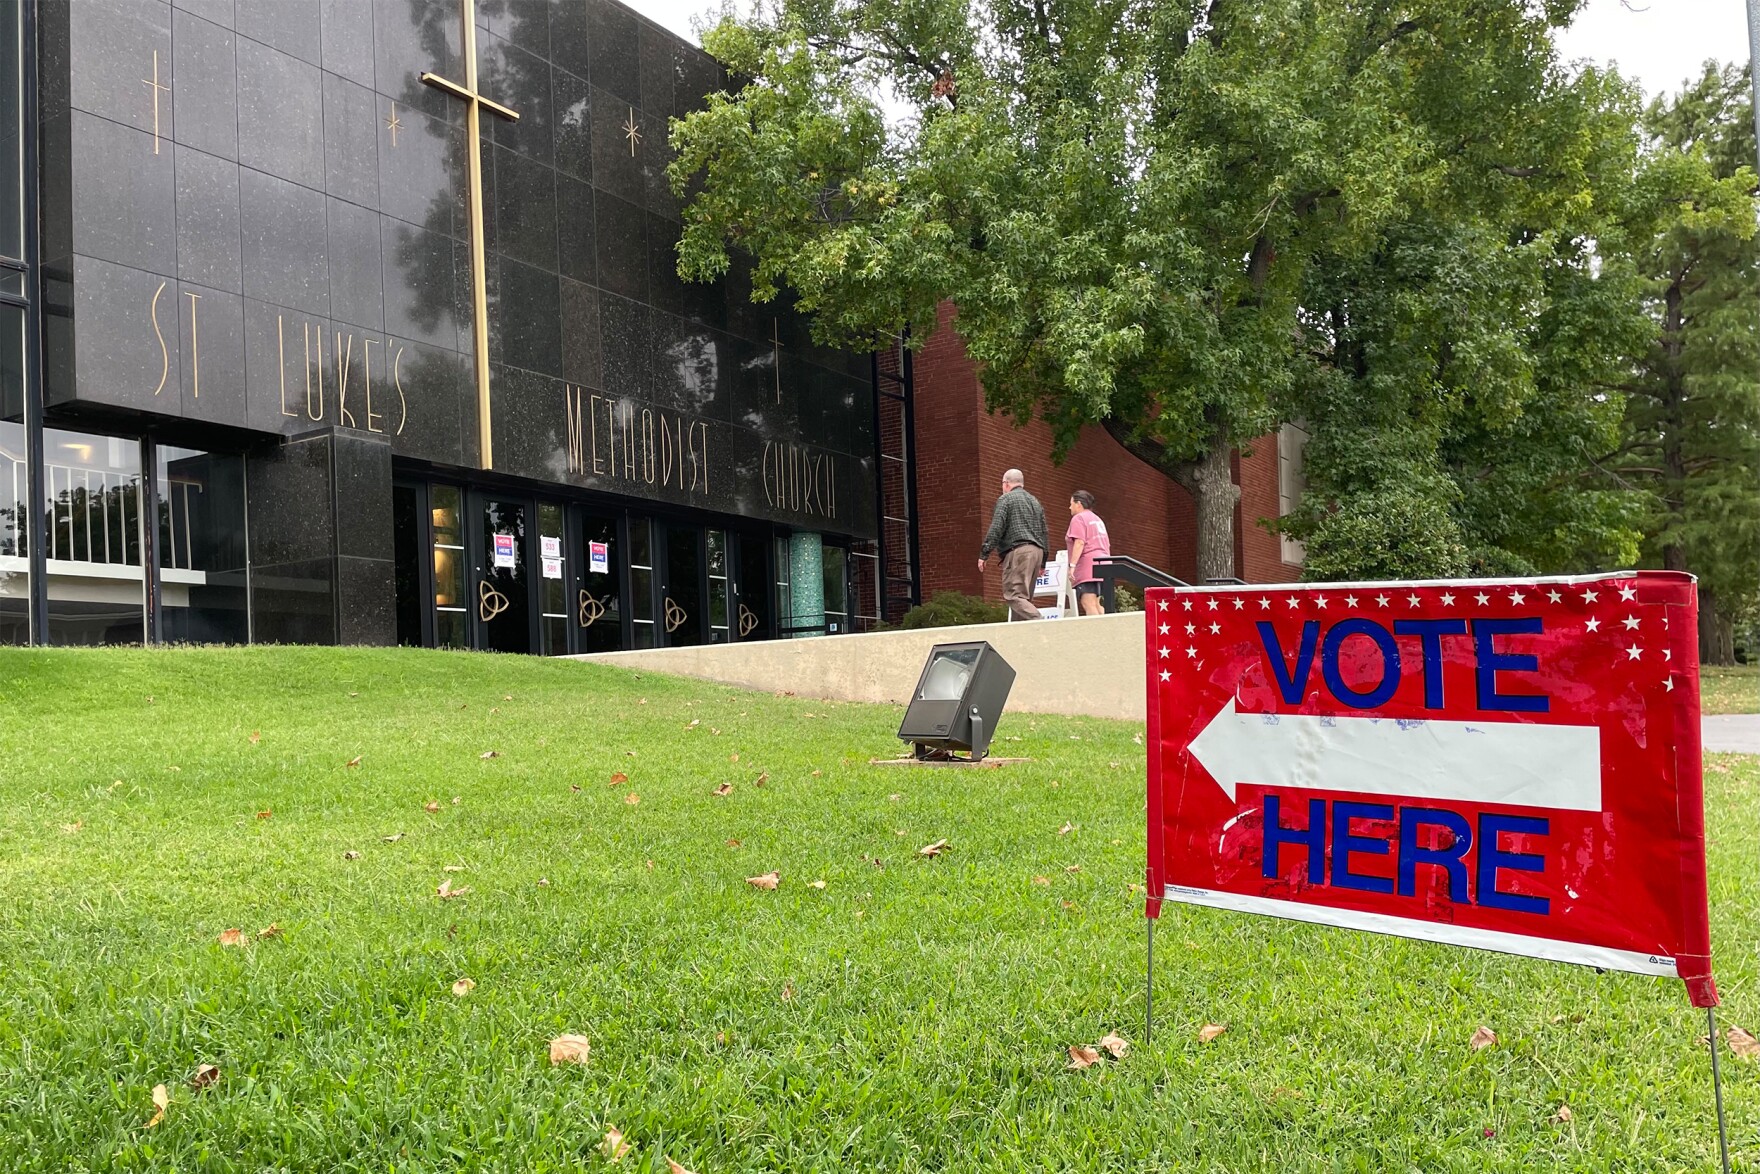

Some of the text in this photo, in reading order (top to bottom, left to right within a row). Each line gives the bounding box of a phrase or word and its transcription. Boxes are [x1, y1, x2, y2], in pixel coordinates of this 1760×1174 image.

[151, 281, 406, 435] ST LUKE'S
[565, 383, 836, 519] METHODIST CHURCH
[1257, 617, 1550, 712] VOTE
[1263, 794, 1551, 915] HERE
